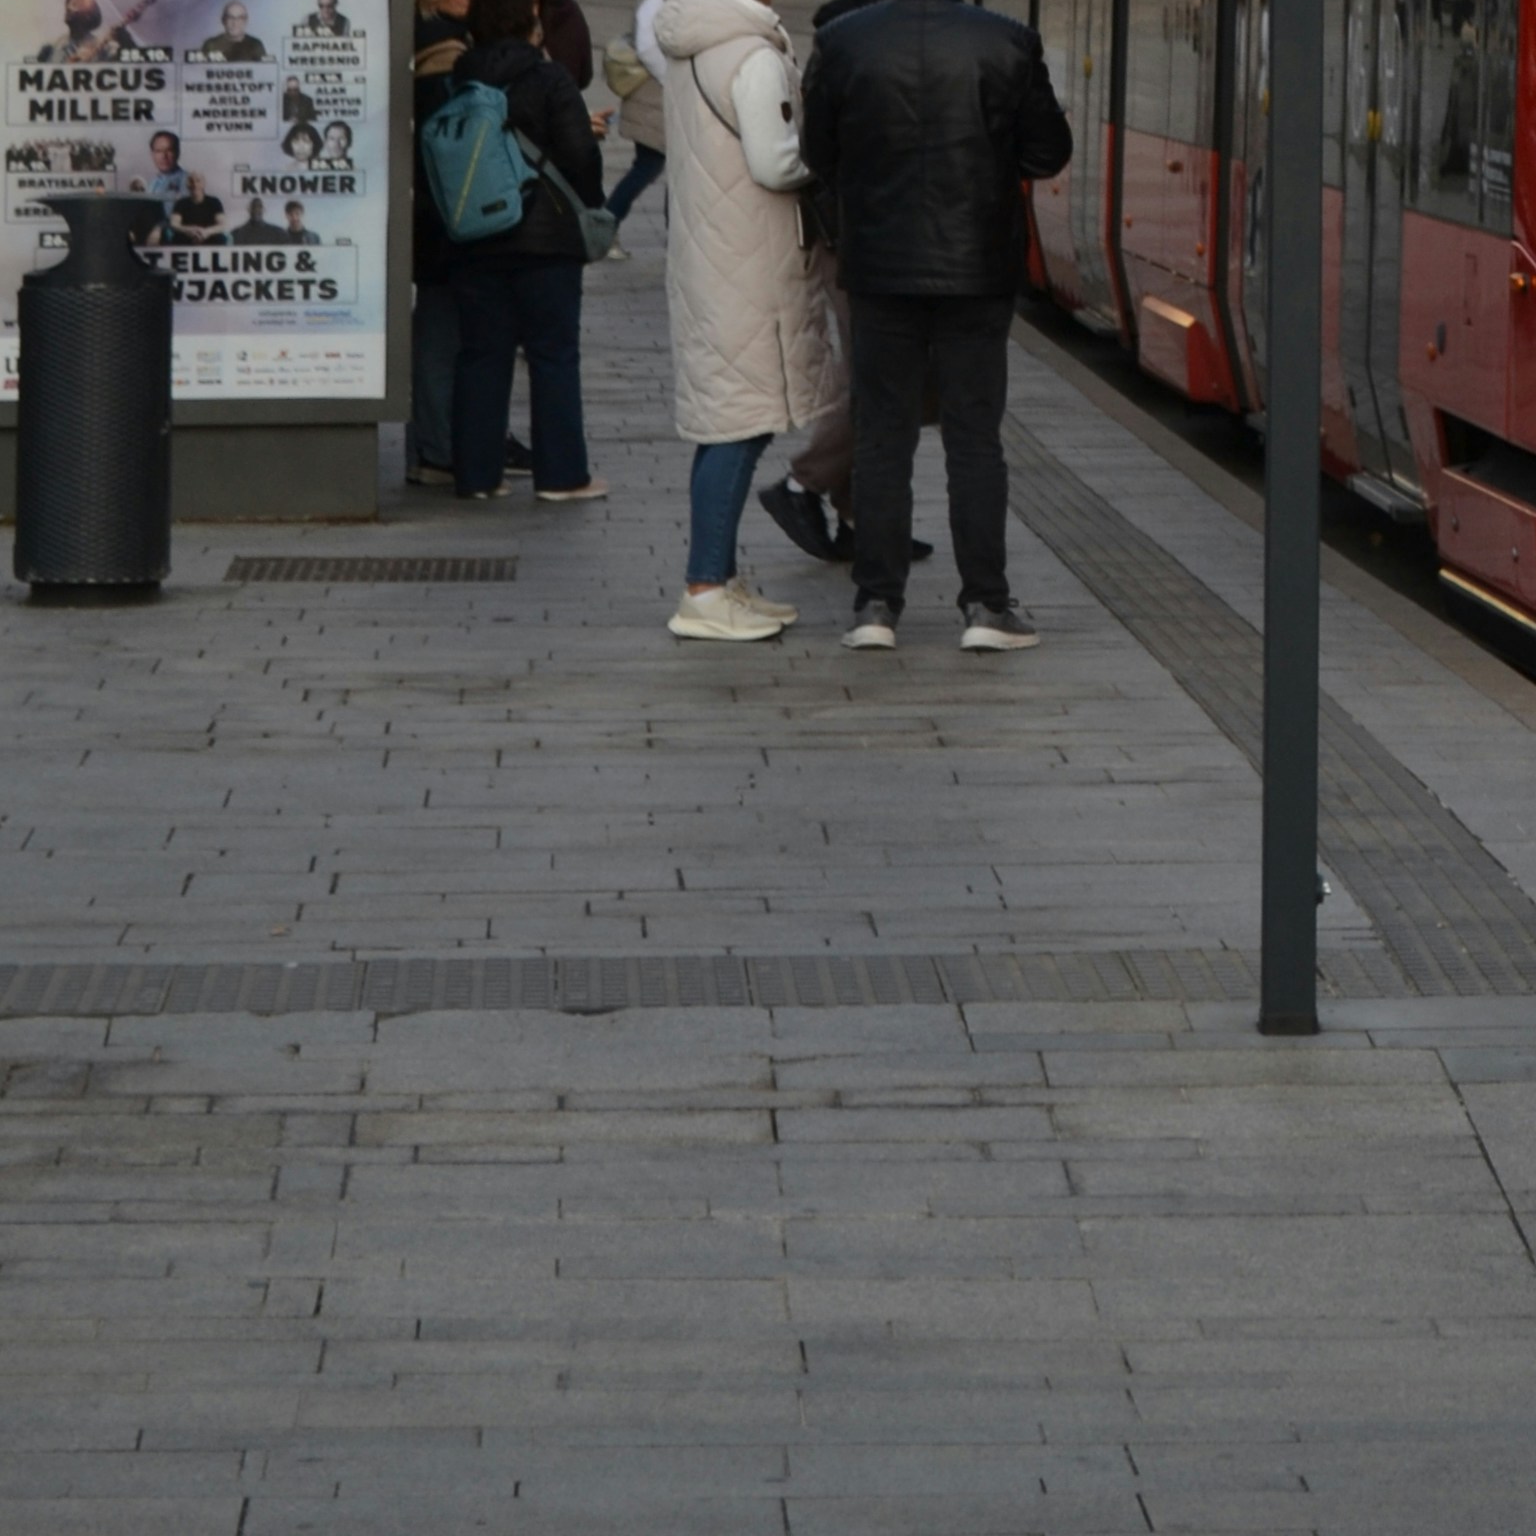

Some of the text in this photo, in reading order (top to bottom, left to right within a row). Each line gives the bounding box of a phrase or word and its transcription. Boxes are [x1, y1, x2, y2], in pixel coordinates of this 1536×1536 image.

[291, 41, 357, 52] RAPHAEL
[17, 67, 167, 93] MARCUS
[28, 97, 156, 123] MILLER
[192, 108, 268, 119] ANDERSEN
[17, 177, 105, 189] BRATISLAVA
[241, 174, 358, 195] KNOWER
[14, 206, 54, 218] SERE
[143, 249, 317, 274] T ELLING &
[171, 278, 339, 303] WJACKETS
